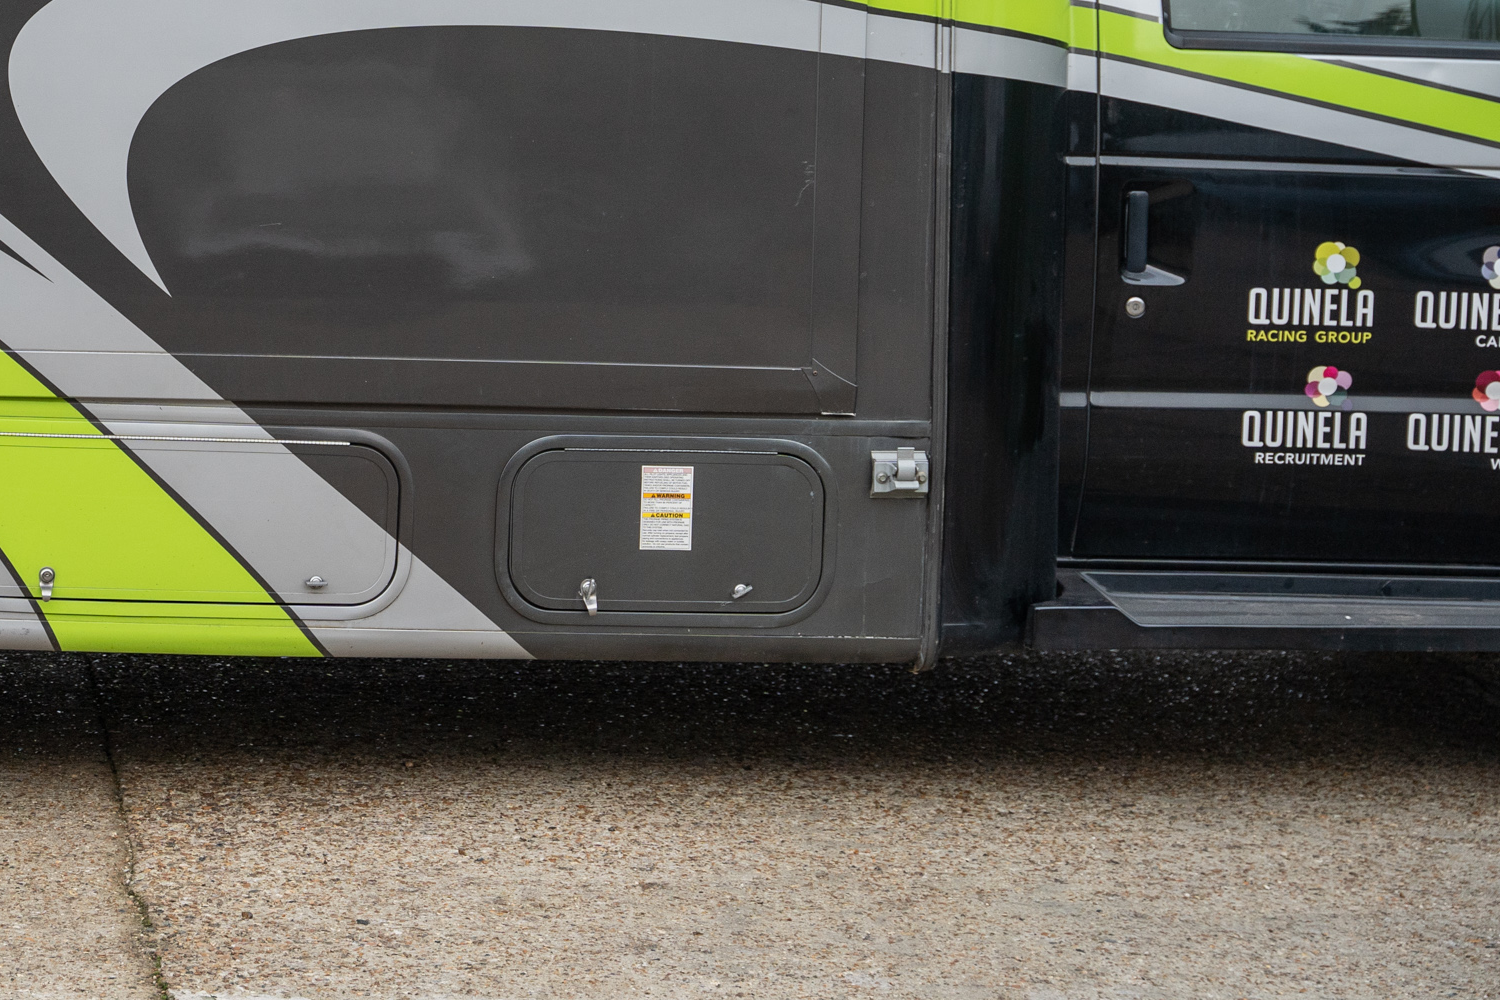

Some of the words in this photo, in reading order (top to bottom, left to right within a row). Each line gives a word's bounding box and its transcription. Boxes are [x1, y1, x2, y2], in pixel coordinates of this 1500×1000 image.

[1248, 288, 1375, 327] QUINELA
[1246, 330, 1307, 342] RACING
[1315, 331, 1372, 344] GROUP
[1476, 335, 1500, 348] CA
[1241, 410, 1367, 449] QUINELA
[1407, 413, 1500, 453] QUINE
[1254, 452, 1365, 466] RECRUITMENT
